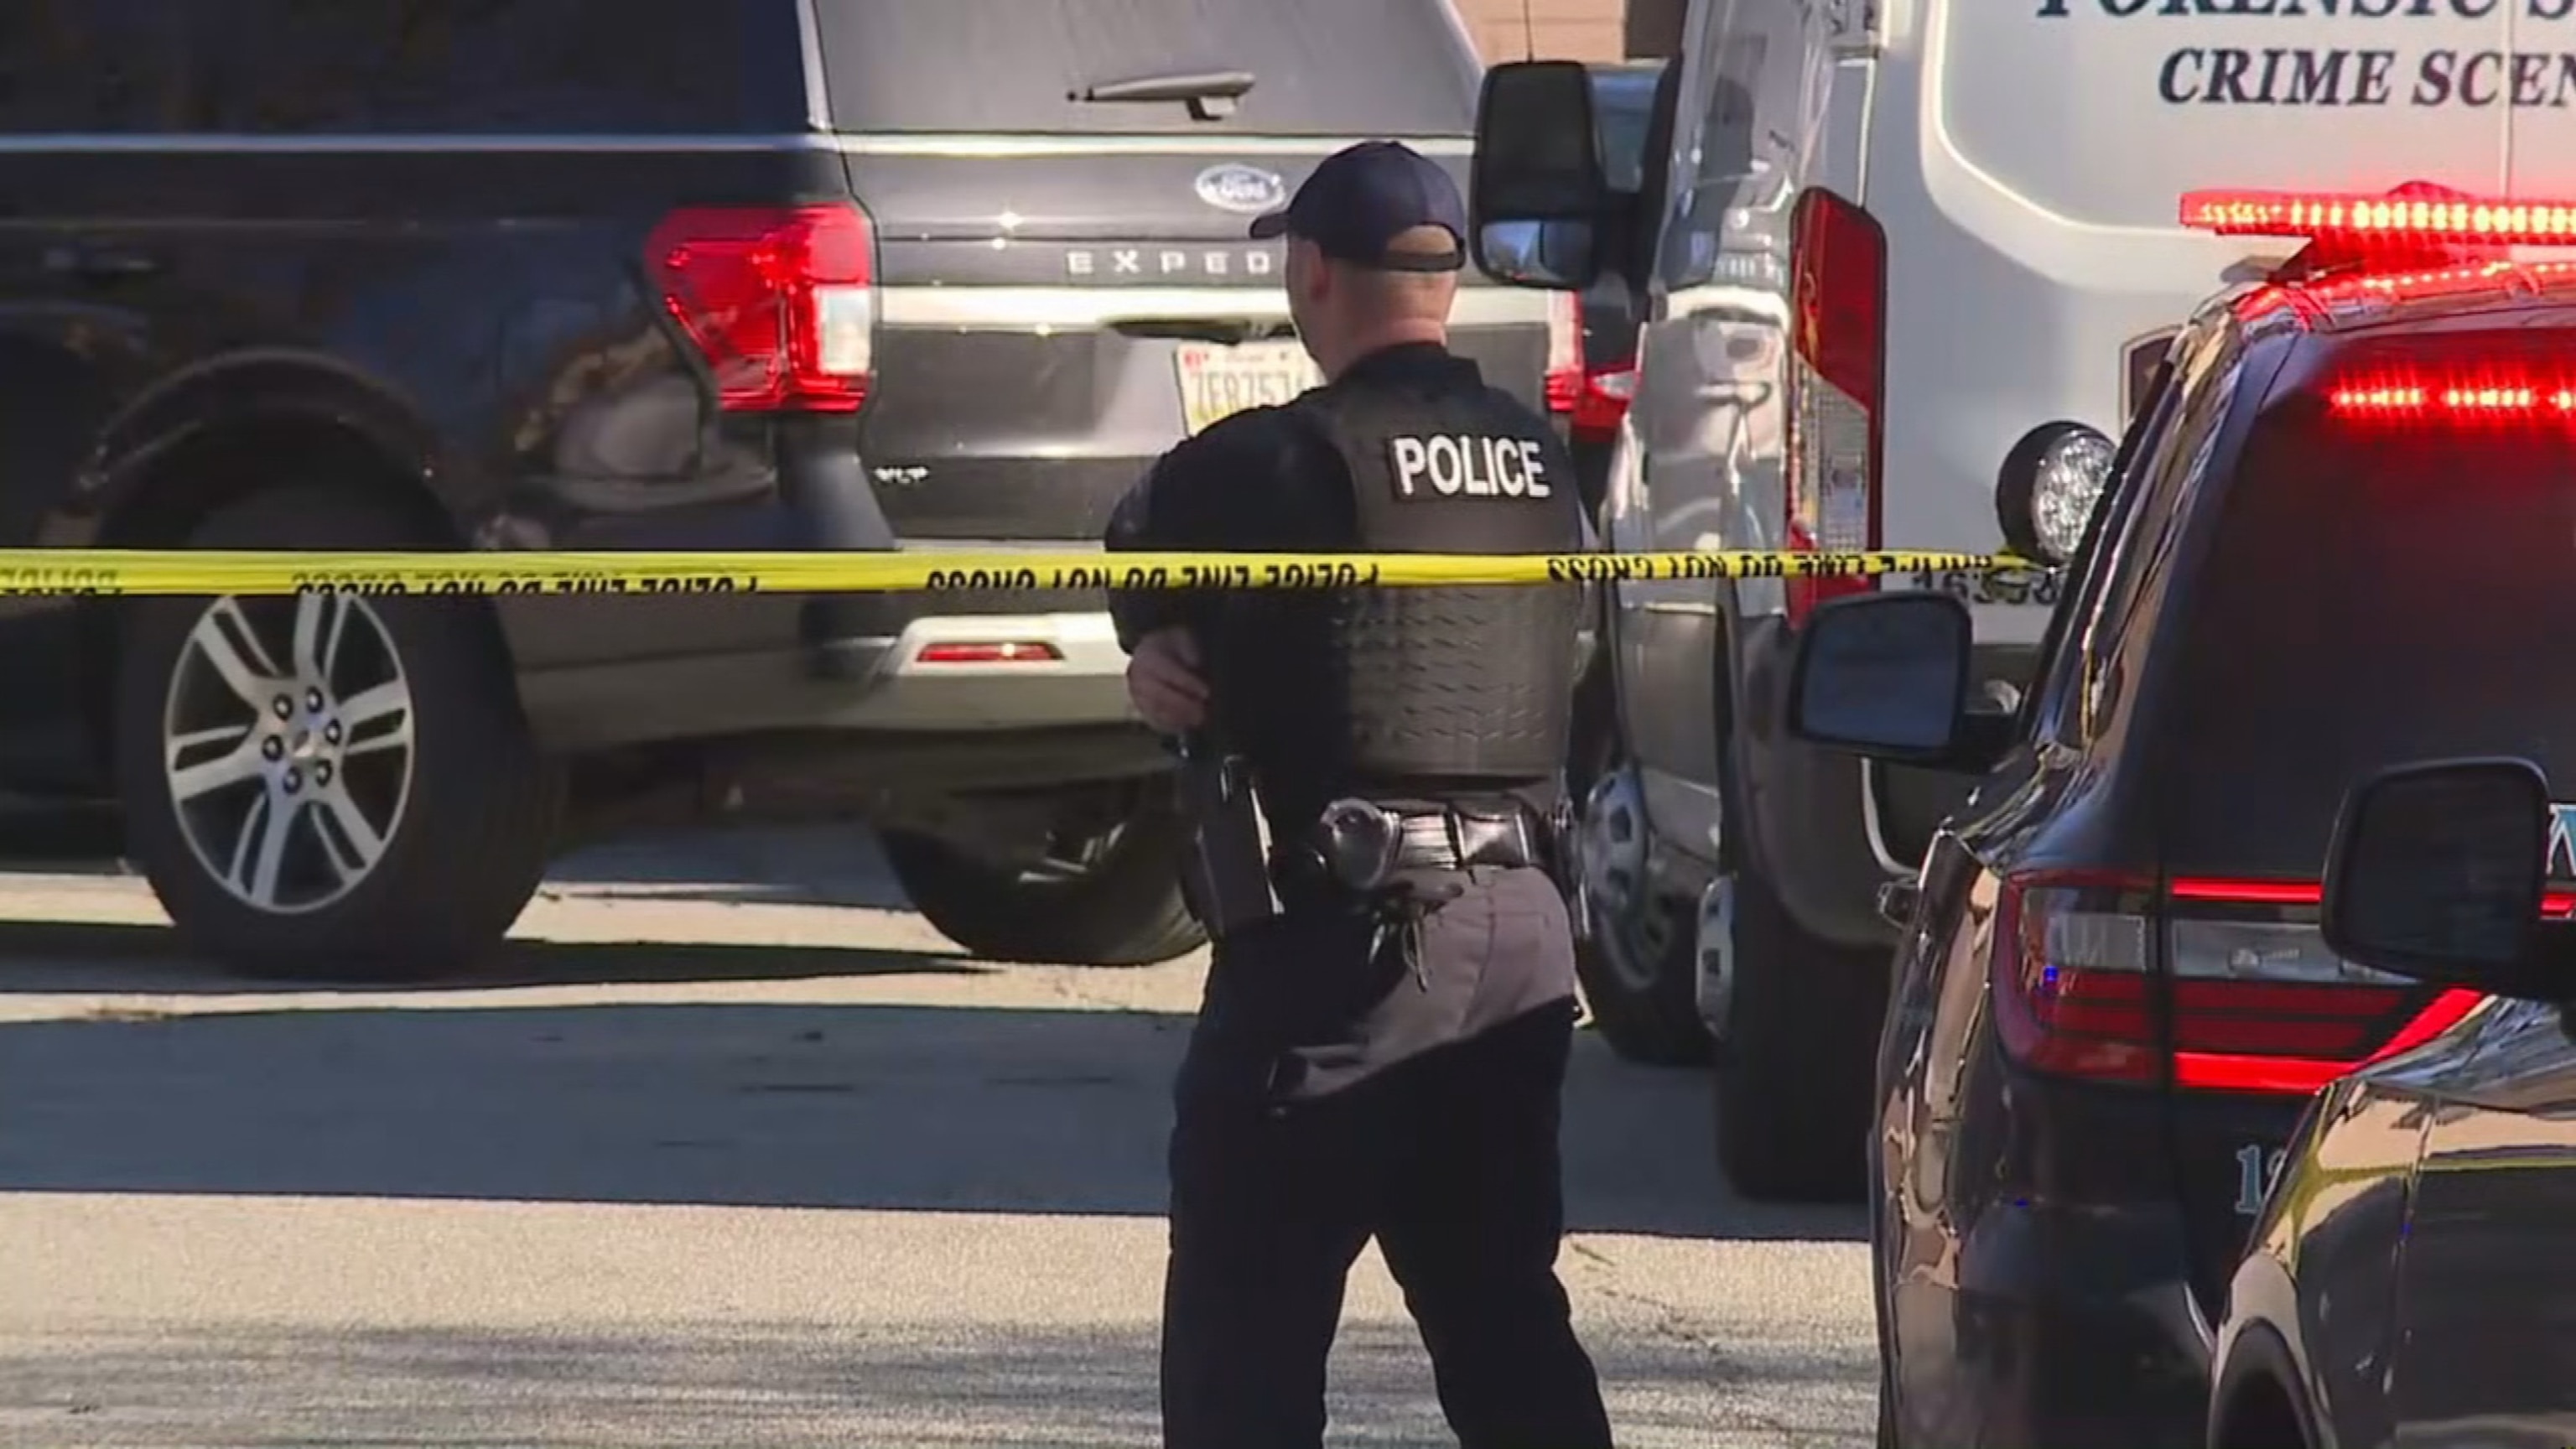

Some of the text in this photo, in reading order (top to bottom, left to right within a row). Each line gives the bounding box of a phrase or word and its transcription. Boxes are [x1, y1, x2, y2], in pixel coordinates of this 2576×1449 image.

[2158, 48, 2395, 106] CRIME
[1067, 250, 1270, 274] EXPED
[1394, 434, 1550, 498] POLICE
